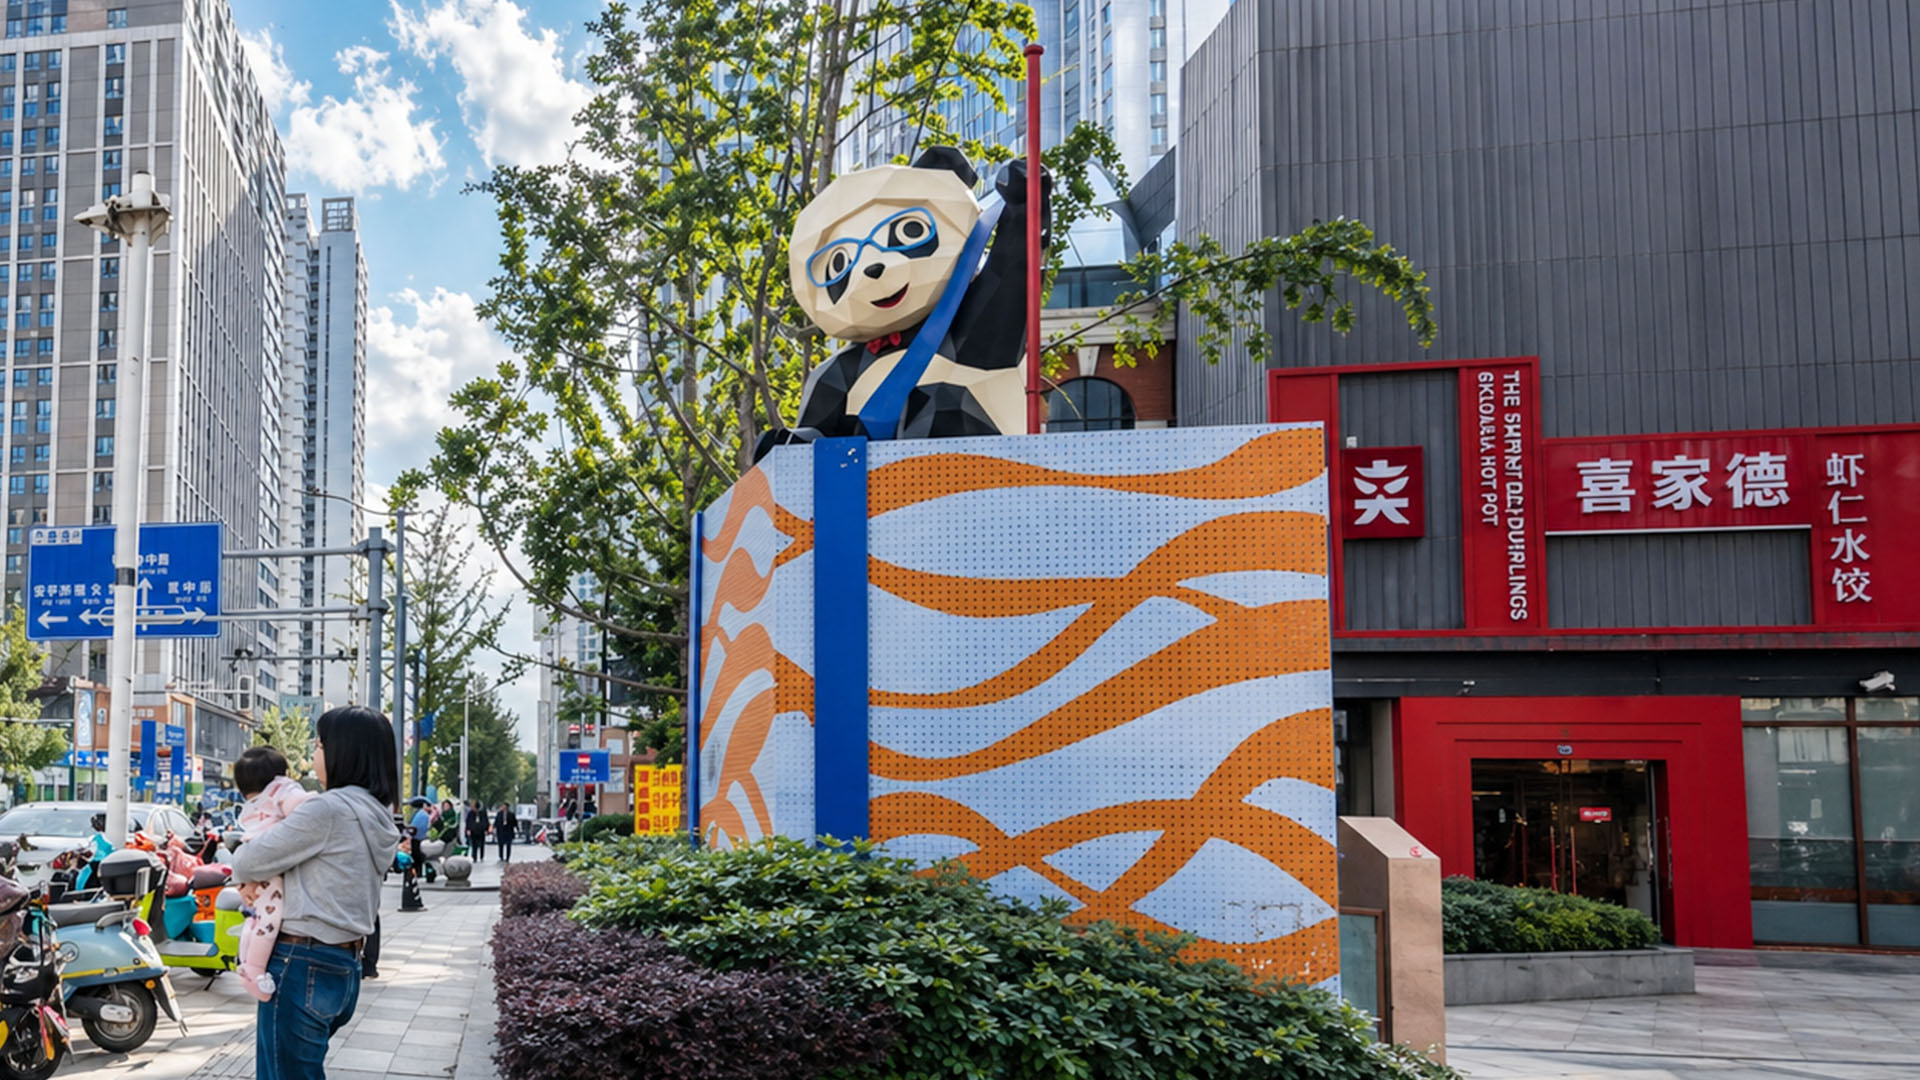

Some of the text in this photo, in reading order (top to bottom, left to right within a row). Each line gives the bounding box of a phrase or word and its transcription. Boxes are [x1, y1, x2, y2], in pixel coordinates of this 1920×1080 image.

[1503, 370, 1521, 407] THE
[1480, 455, 1497, 489] HOT
[1576, 451, 1790, 514] 喜家德
[1481, 492, 1499, 526] POT
[1826, 452, 1872, 603] 虾仁水饺
